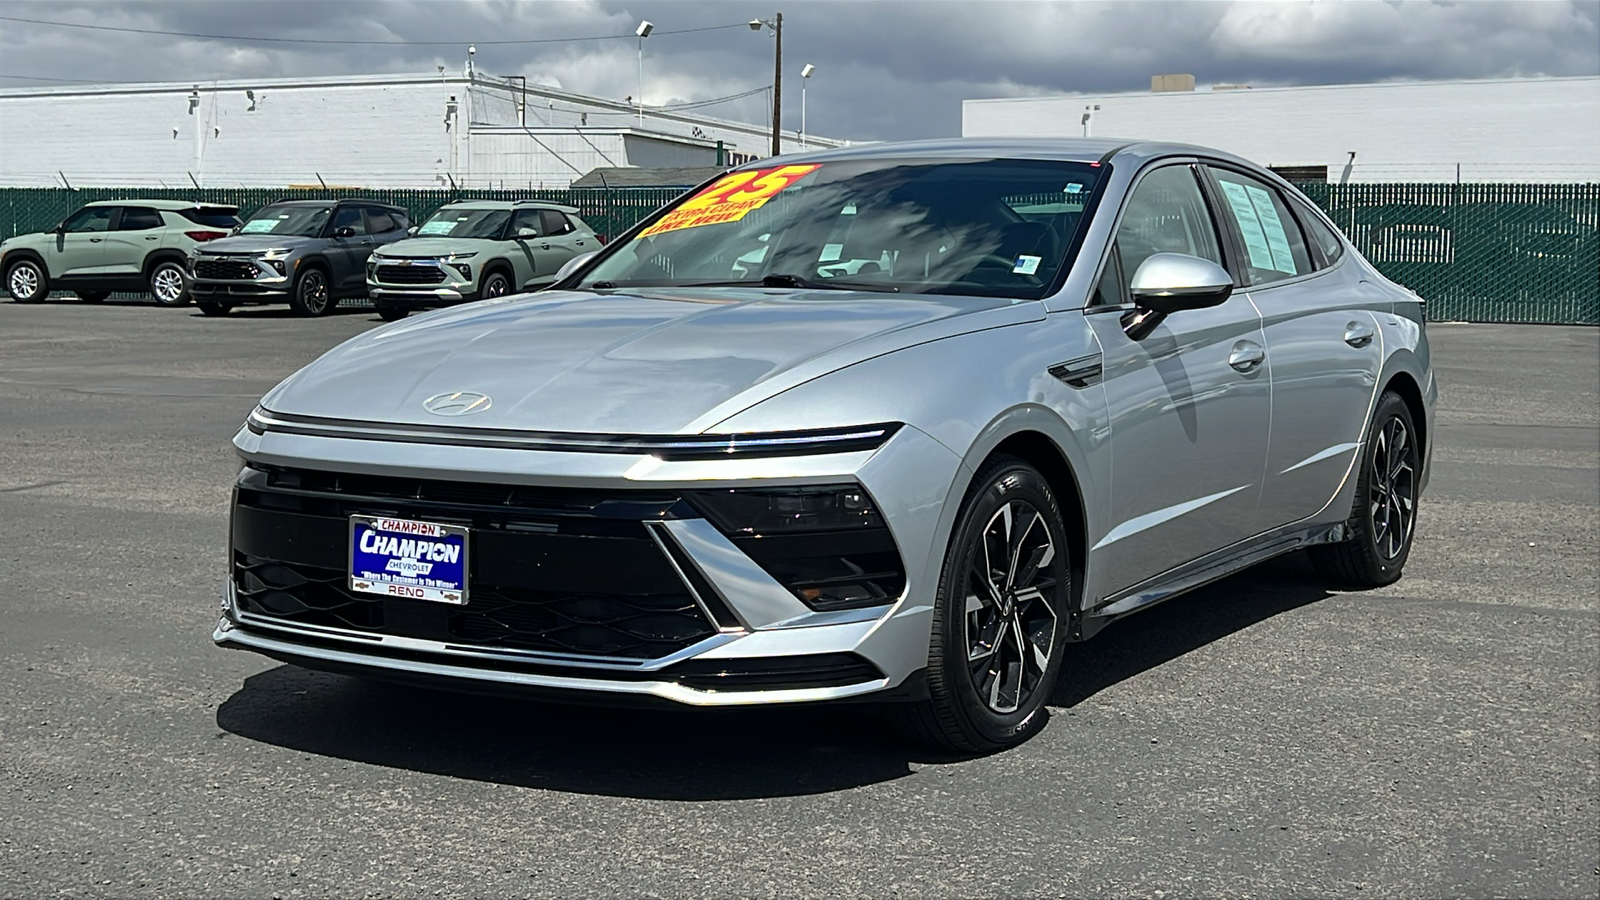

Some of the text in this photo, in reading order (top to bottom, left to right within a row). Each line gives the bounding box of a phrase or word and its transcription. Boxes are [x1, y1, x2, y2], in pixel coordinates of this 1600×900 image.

[676, 165, 815, 211] 25
[665, 200, 758, 221] EXTRA CLEAN
[644, 211, 742, 235] LIKE NEW
[382, 520, 435, 535] CHAMPION
[389, 561, 429, 572] CHEVROLET
[381, 573, 391, 582] The
[392, 574, 418, 585] Customer
[425, 578, 435, 587] The
[388, 586, 424, 597] RENO
